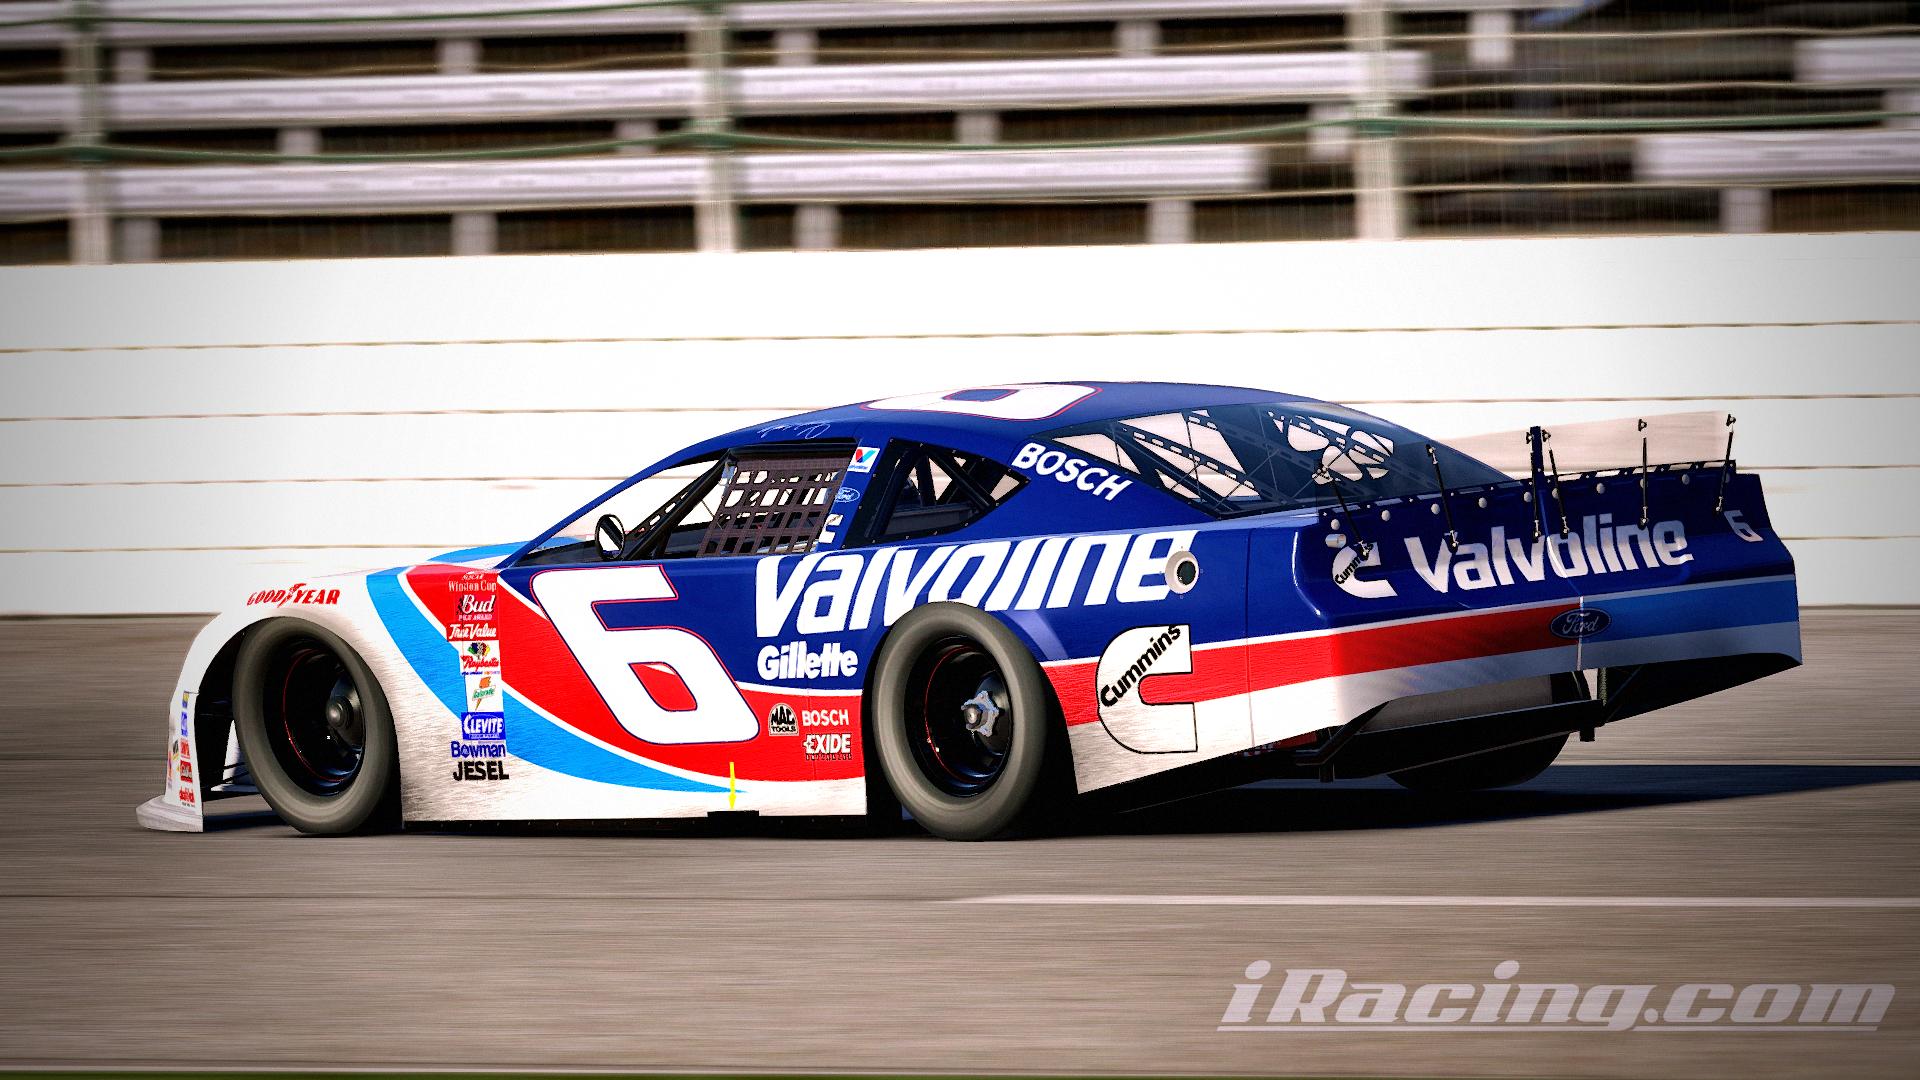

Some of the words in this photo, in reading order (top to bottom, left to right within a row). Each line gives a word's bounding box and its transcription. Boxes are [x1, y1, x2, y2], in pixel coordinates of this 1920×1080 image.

[1011, 442, 1134, 501] BOSCH
[1723, 510, 1763, 542] 6
[1404, 513, 1694, 593] Valvoline
[448, 580, 479, 592] Winston
[480, 580, 497, 592] Cup
[756, 530, 1201, 637] Valvoline
[462, 594, 496, 614] Bud
[1562, 611, 1600, 635] Ford
[529, 564, 760, 745] 6
[757, 640, 858, 681] Gillette
[1100, 625, 1181, 707] Cummins
[463, 714, 504, 734] CLEVITE
[801, 709, 849, 726] BOSCH
[771, 725, 797, 733] TOOLS
[450, 741, 507, 758] Bowman
[803, 733, 852, 754] EXIDE
[453, 760, 510, 781] JESEL
